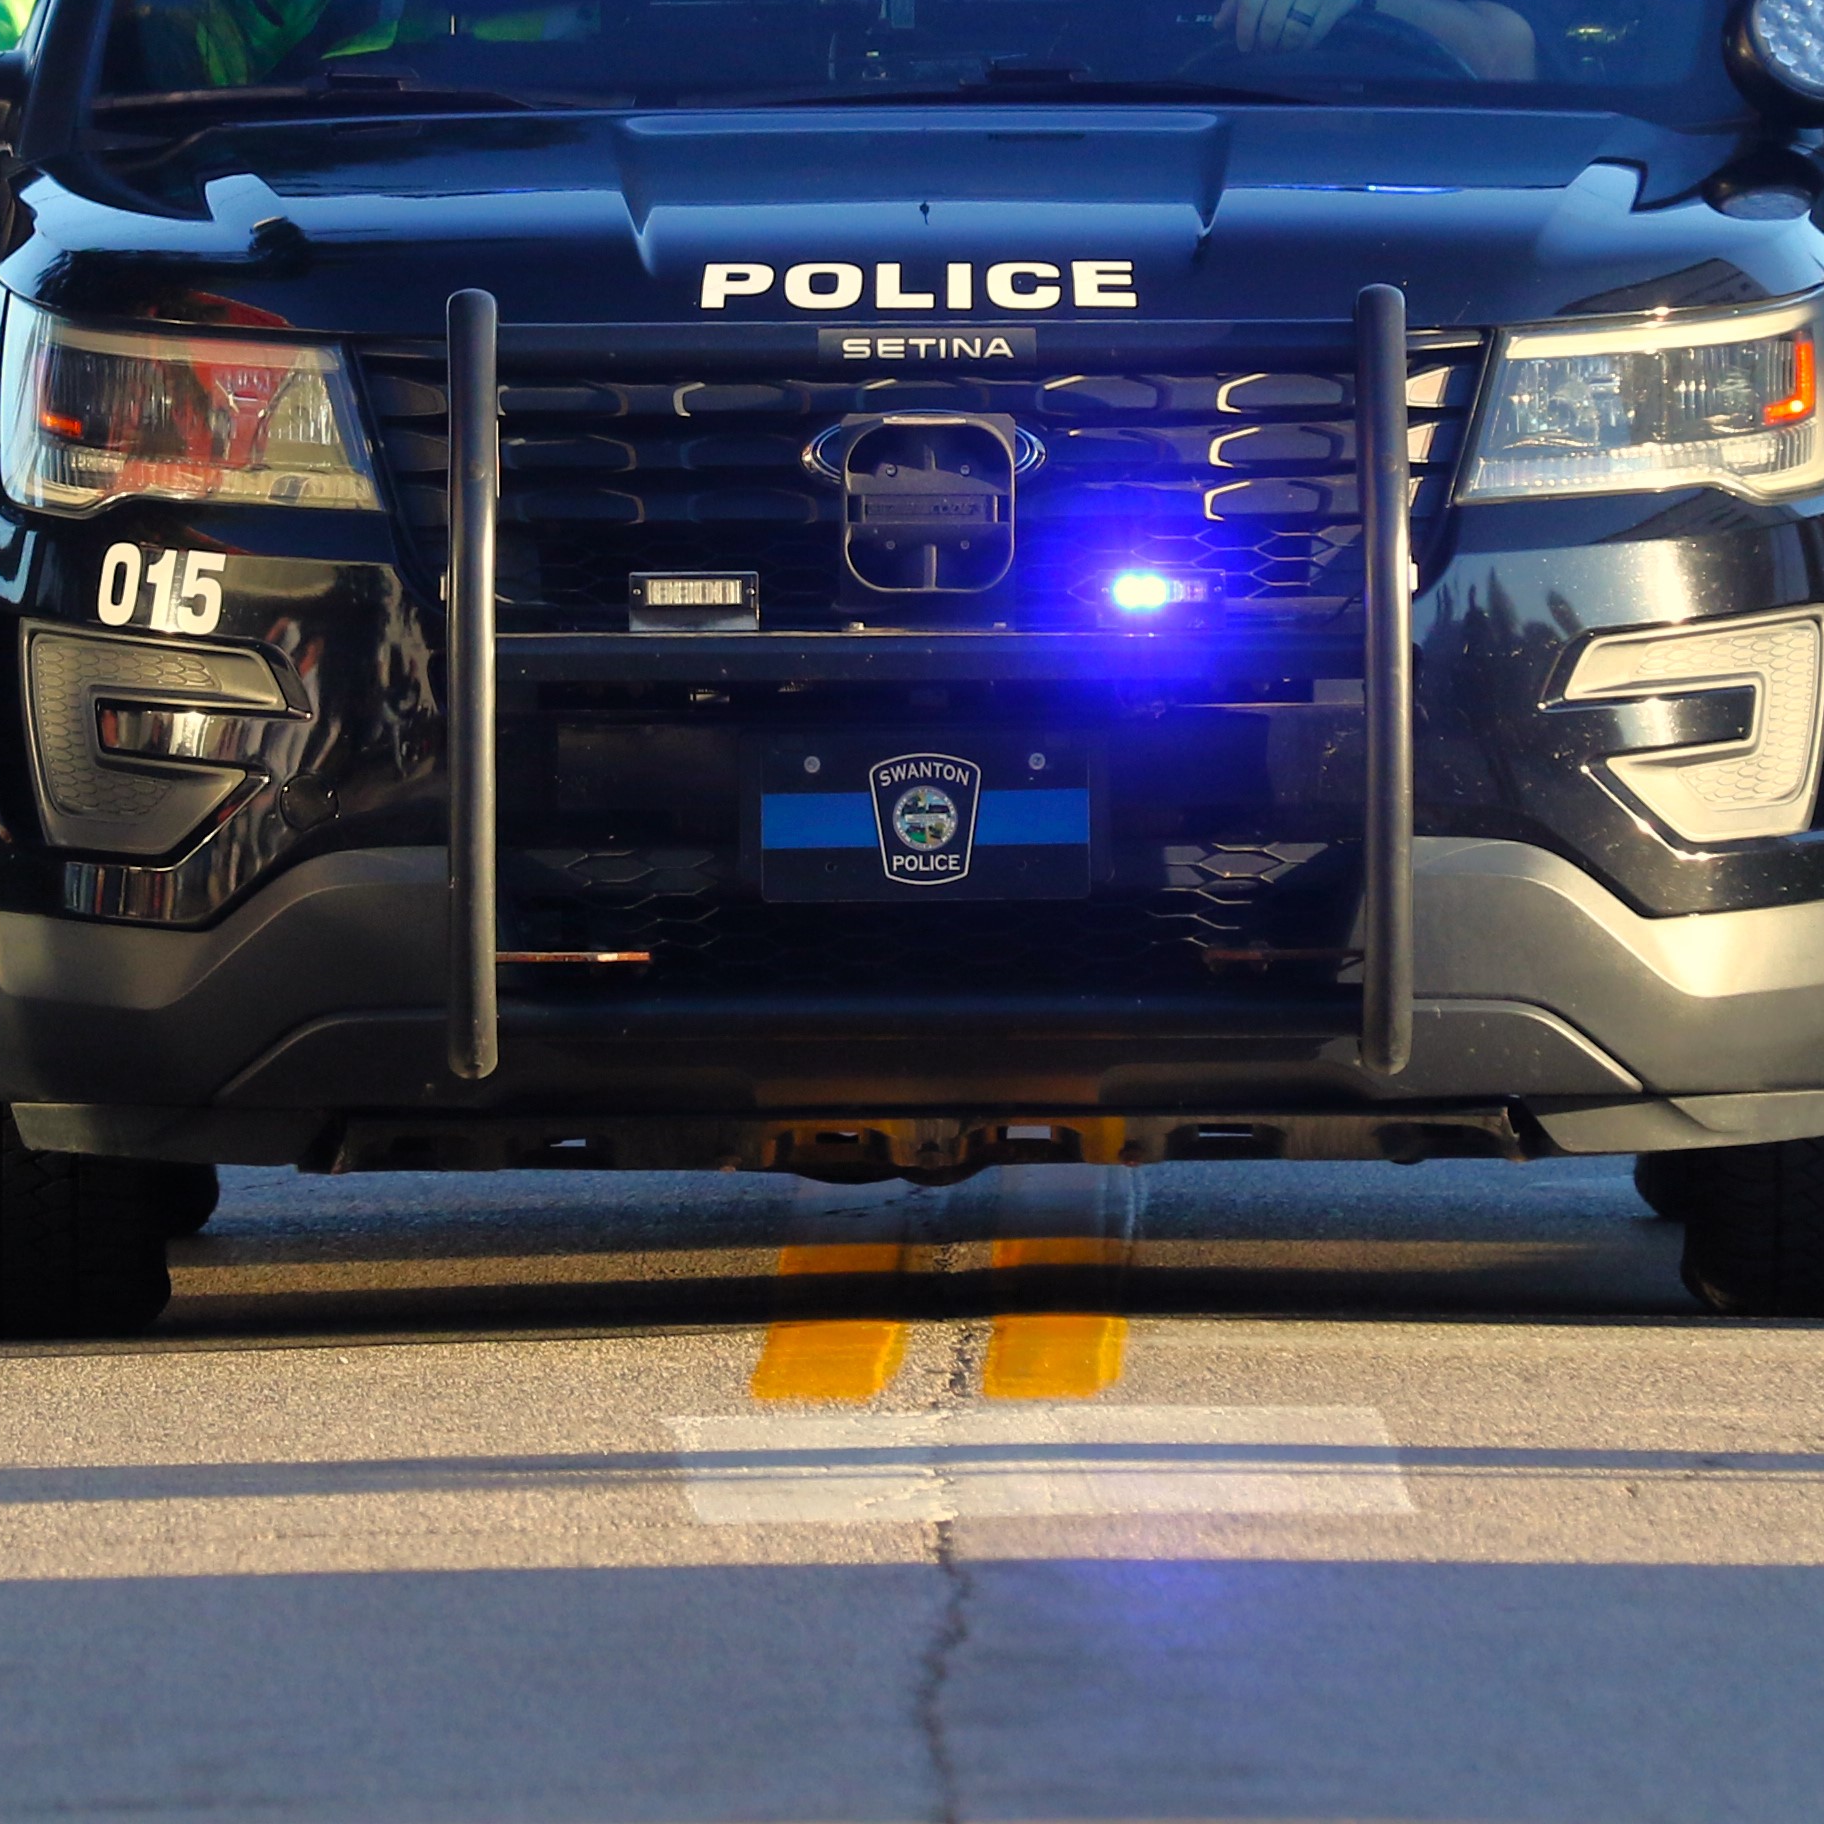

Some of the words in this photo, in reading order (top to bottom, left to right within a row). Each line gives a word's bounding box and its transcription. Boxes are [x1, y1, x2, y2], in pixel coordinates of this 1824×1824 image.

[699, 261, 1138, 310] POLICE
[841, 337, 1014, 360] SETINA
[97, 541, 227, 636] 015
[879, 762, 970, 787] SWANTON
[893, 854, 961, 872] POLICE
